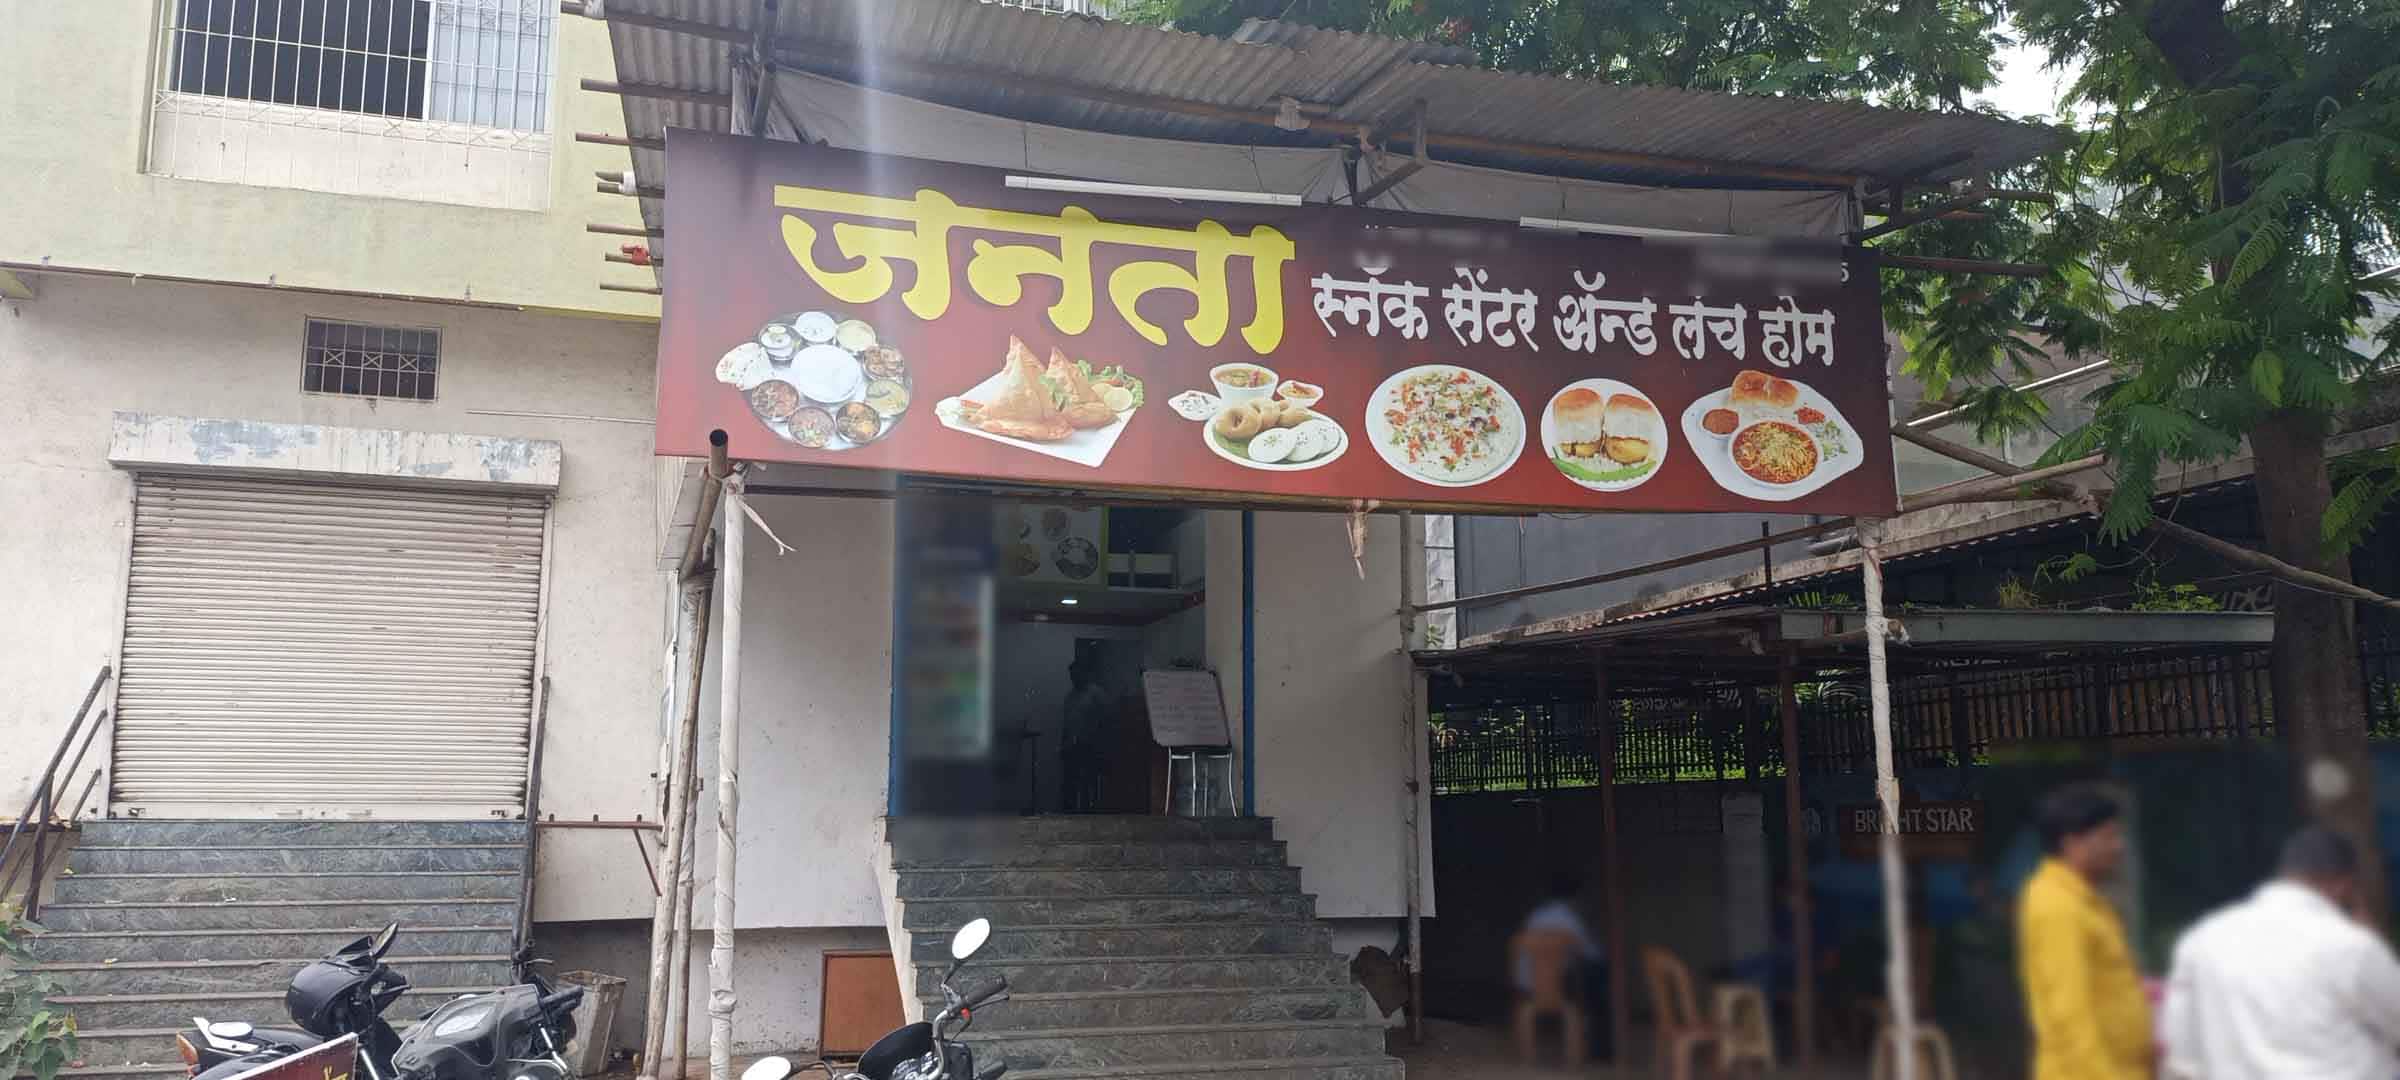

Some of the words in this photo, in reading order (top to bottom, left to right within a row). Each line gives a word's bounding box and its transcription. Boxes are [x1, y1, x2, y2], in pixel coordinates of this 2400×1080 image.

[774, 184, 1295, 354] जनता
[1441, 264, 1539, 352] सेंटर
[1758, 293, 1836, 367] होम
[1855, 807, 1920, 833] BRHT
[1926, 807, 1975, 832] STAR
